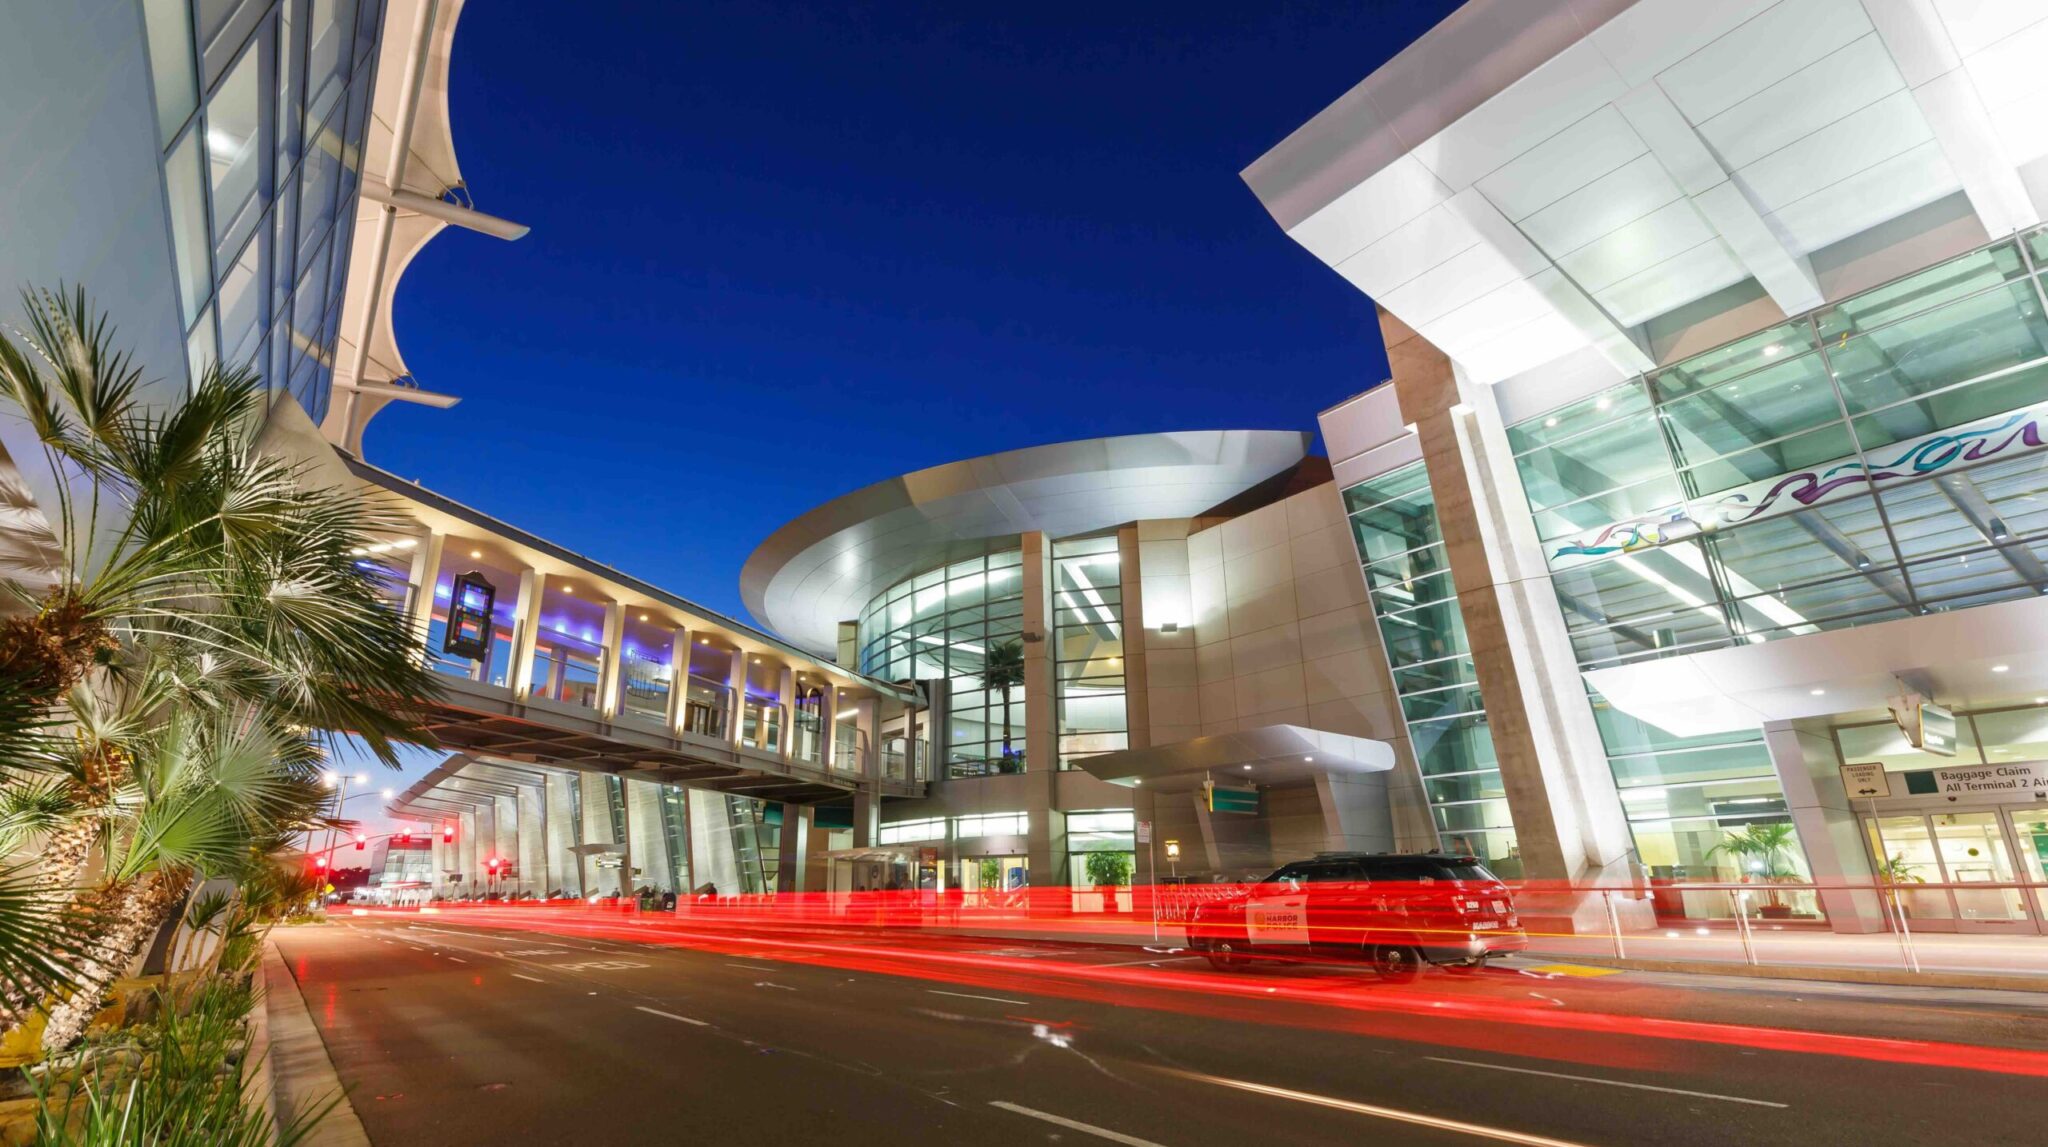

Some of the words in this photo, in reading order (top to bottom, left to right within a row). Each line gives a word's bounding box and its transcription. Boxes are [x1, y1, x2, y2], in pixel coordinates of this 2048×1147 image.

[1940, 769, 1992, 781] Baggage
[1996, 766, 2031, 777] Claim
[1946, 782, 1961, 792] All
[1964, 779, 2017, 791] Terminal
[2020, 779, 2029, 787] 2
[1266, 914, 1298, 922] HARBOR
[1266, 922, 1298, 930] POLICE
